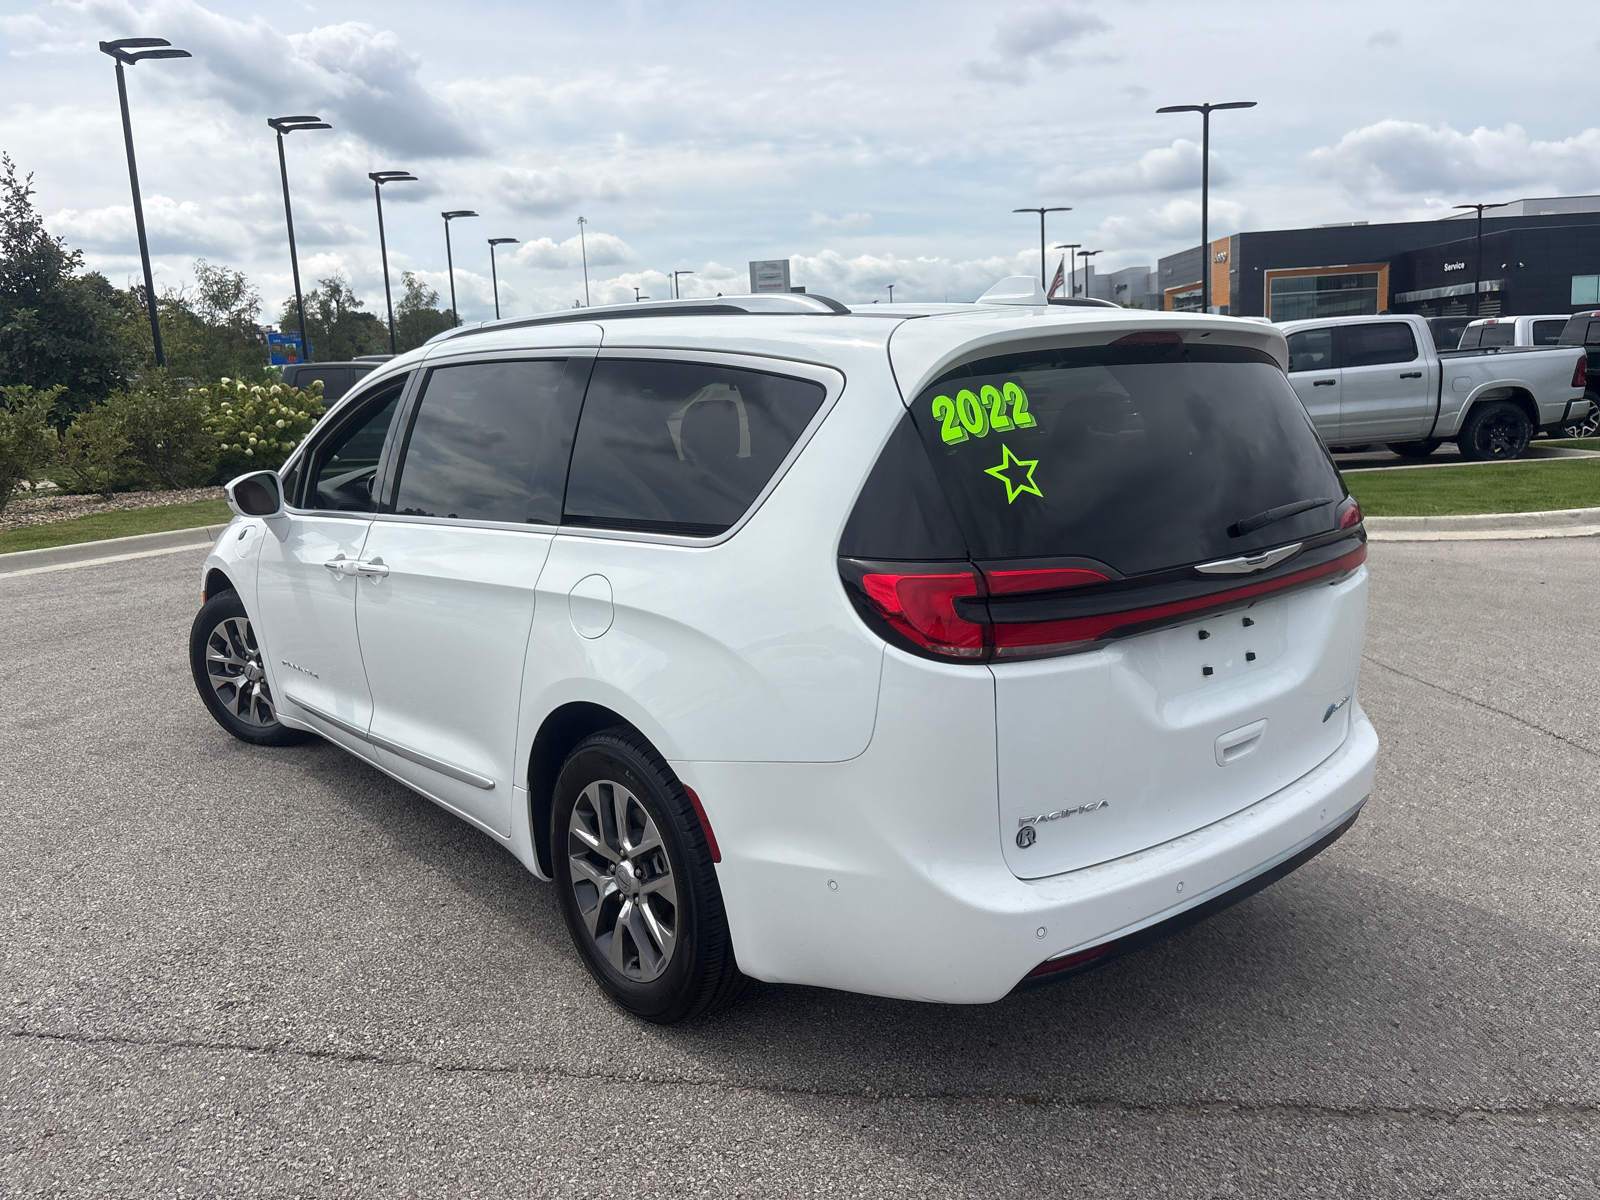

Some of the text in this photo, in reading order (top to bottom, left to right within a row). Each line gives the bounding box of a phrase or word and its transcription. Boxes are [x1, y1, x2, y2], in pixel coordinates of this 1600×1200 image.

[1444, 261, 1465, 272] Service
[932, 382, 1037, 445] 2022
[1018, 799, 1109, 827] PACIFICA
